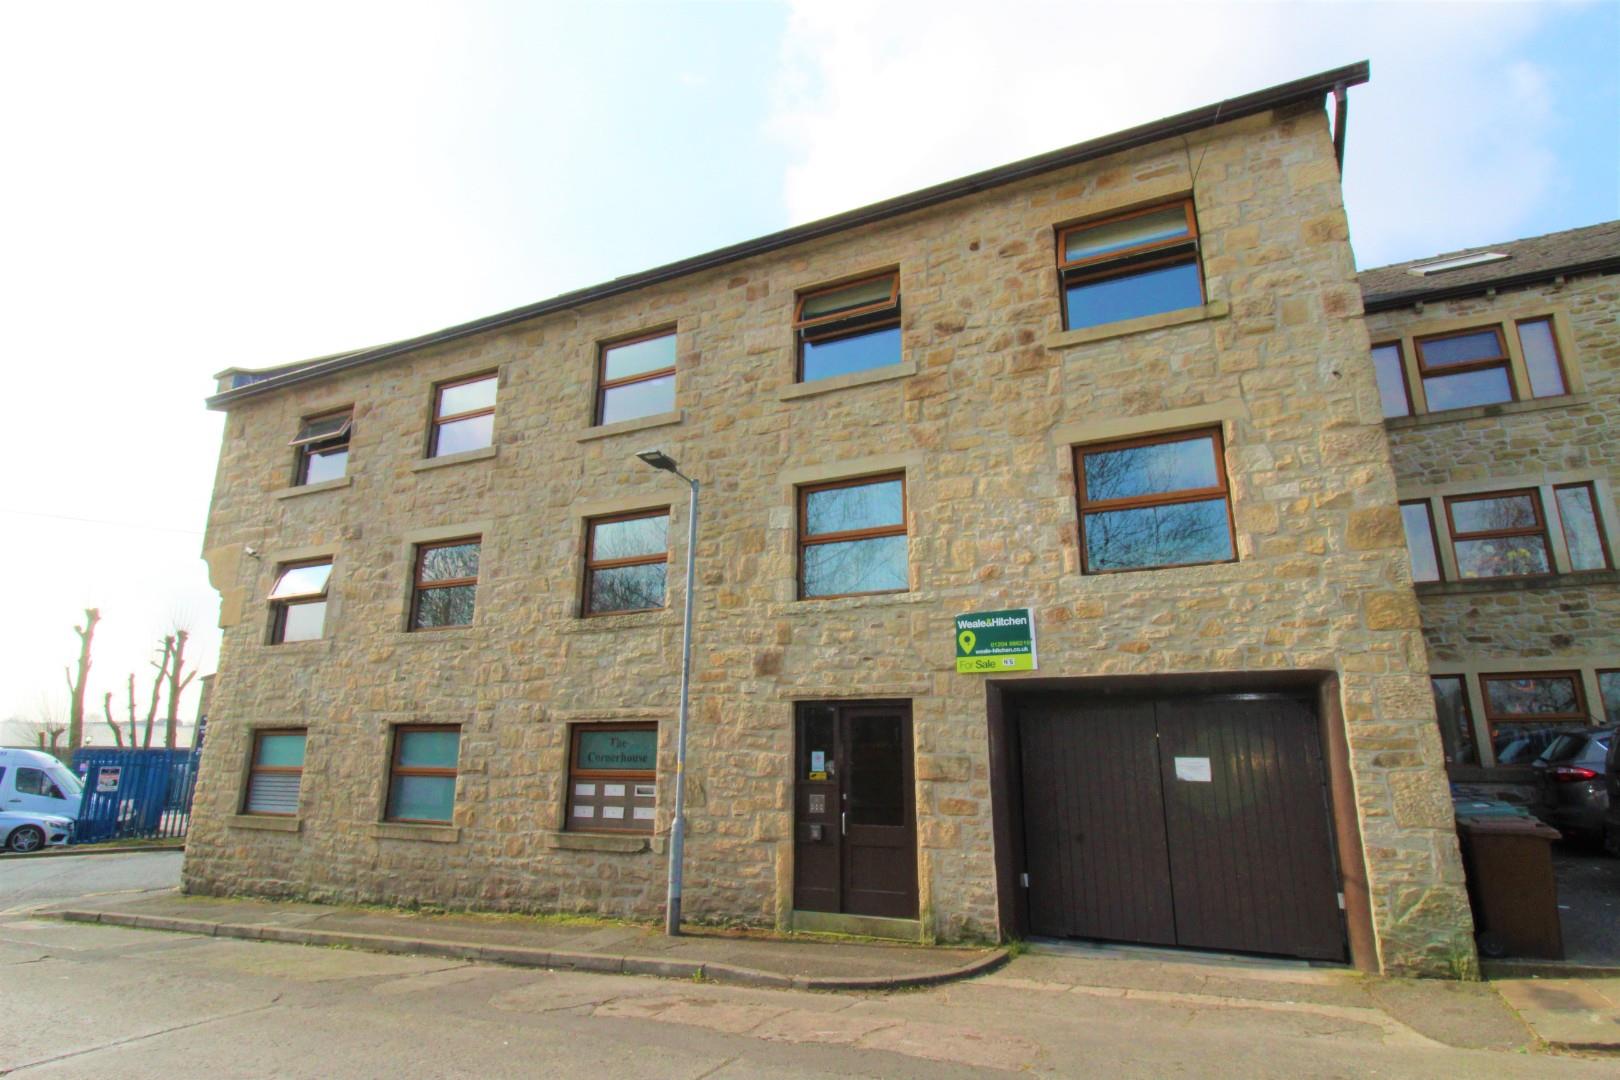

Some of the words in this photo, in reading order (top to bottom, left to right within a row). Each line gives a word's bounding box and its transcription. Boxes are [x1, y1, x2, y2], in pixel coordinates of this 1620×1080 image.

[959, 661, 974, 670] For
[975, 659, 996, 669] Sale
[610, 736, 629, 749] The
[587, 751, 648, 763] Cornerhouse
